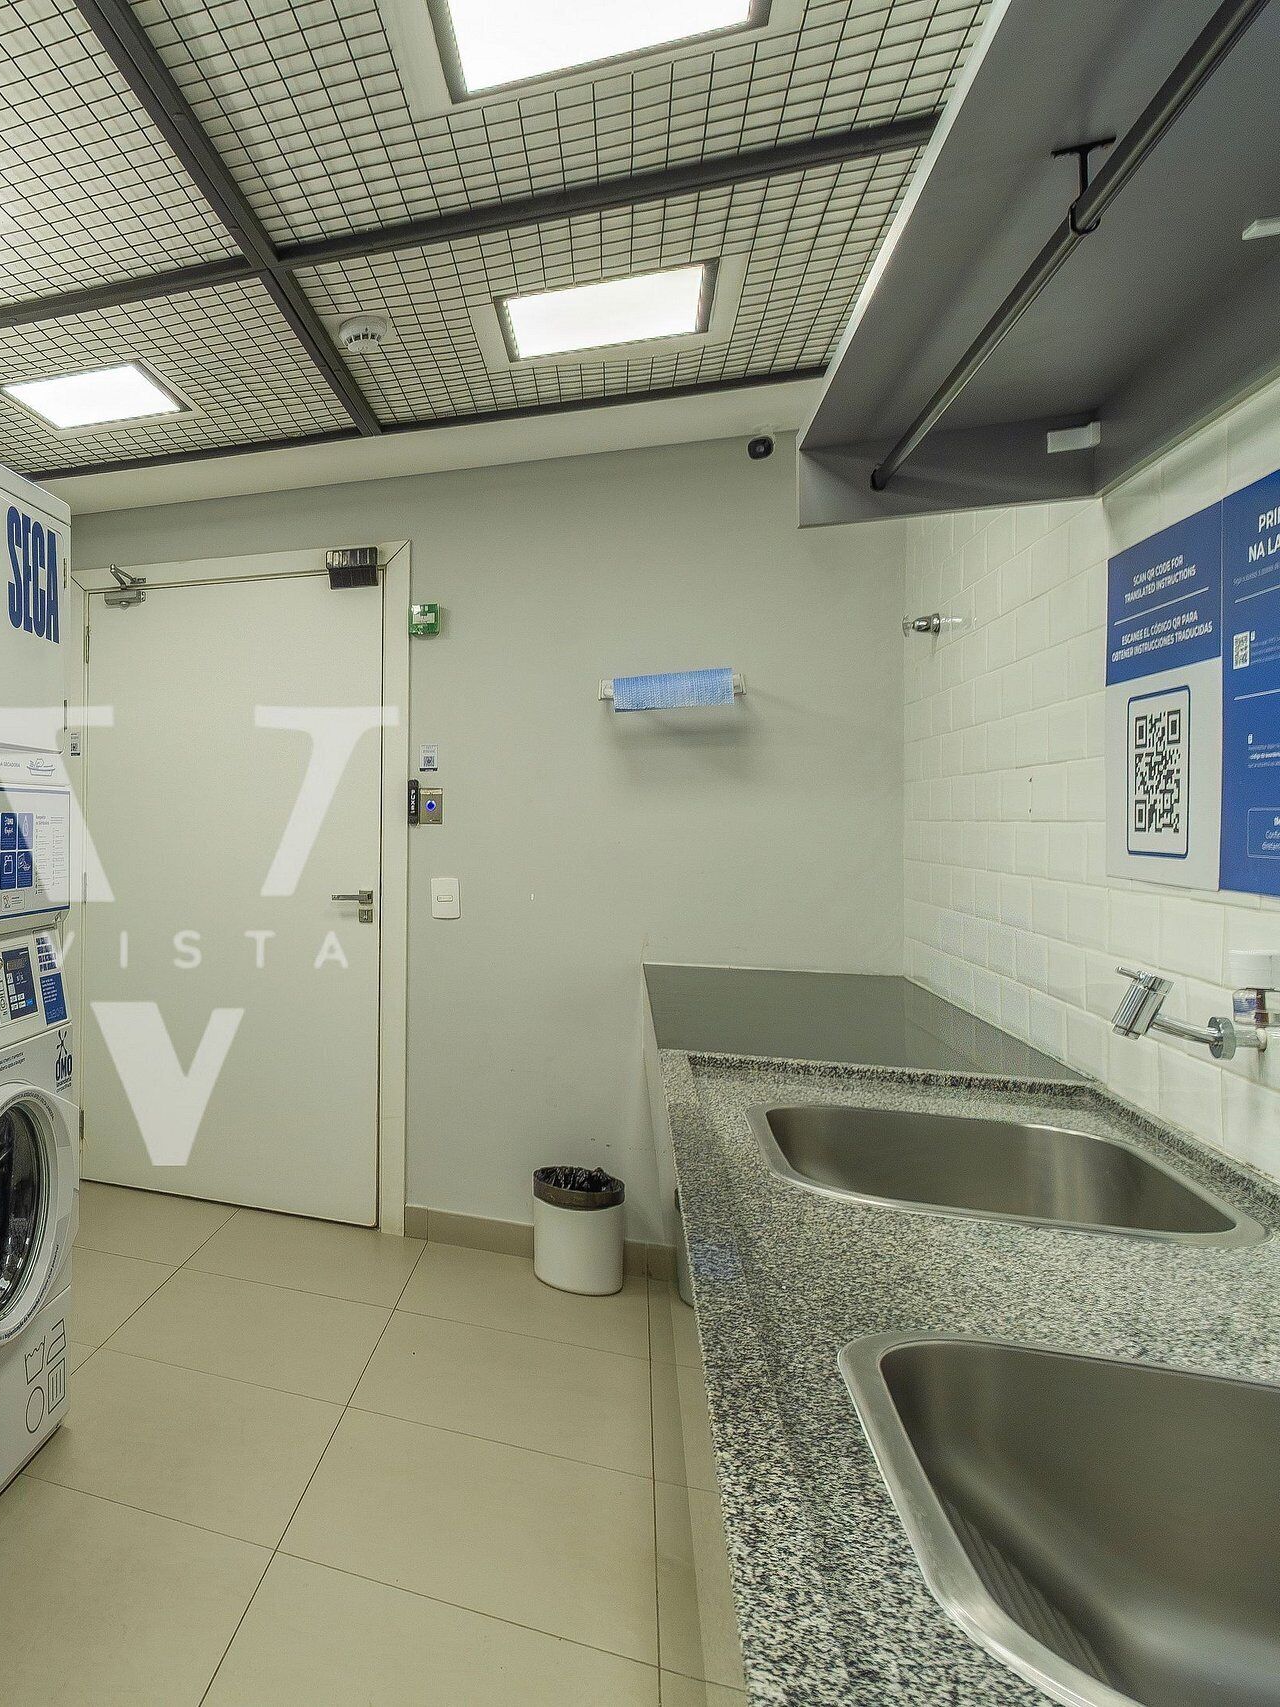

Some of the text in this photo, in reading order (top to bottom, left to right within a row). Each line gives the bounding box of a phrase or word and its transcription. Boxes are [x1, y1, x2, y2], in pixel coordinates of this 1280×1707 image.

[1248, 540, 1266, 563] NA
[6, 505, 61, 644] SECA
[55, 1054, 73, 1082] OMO
